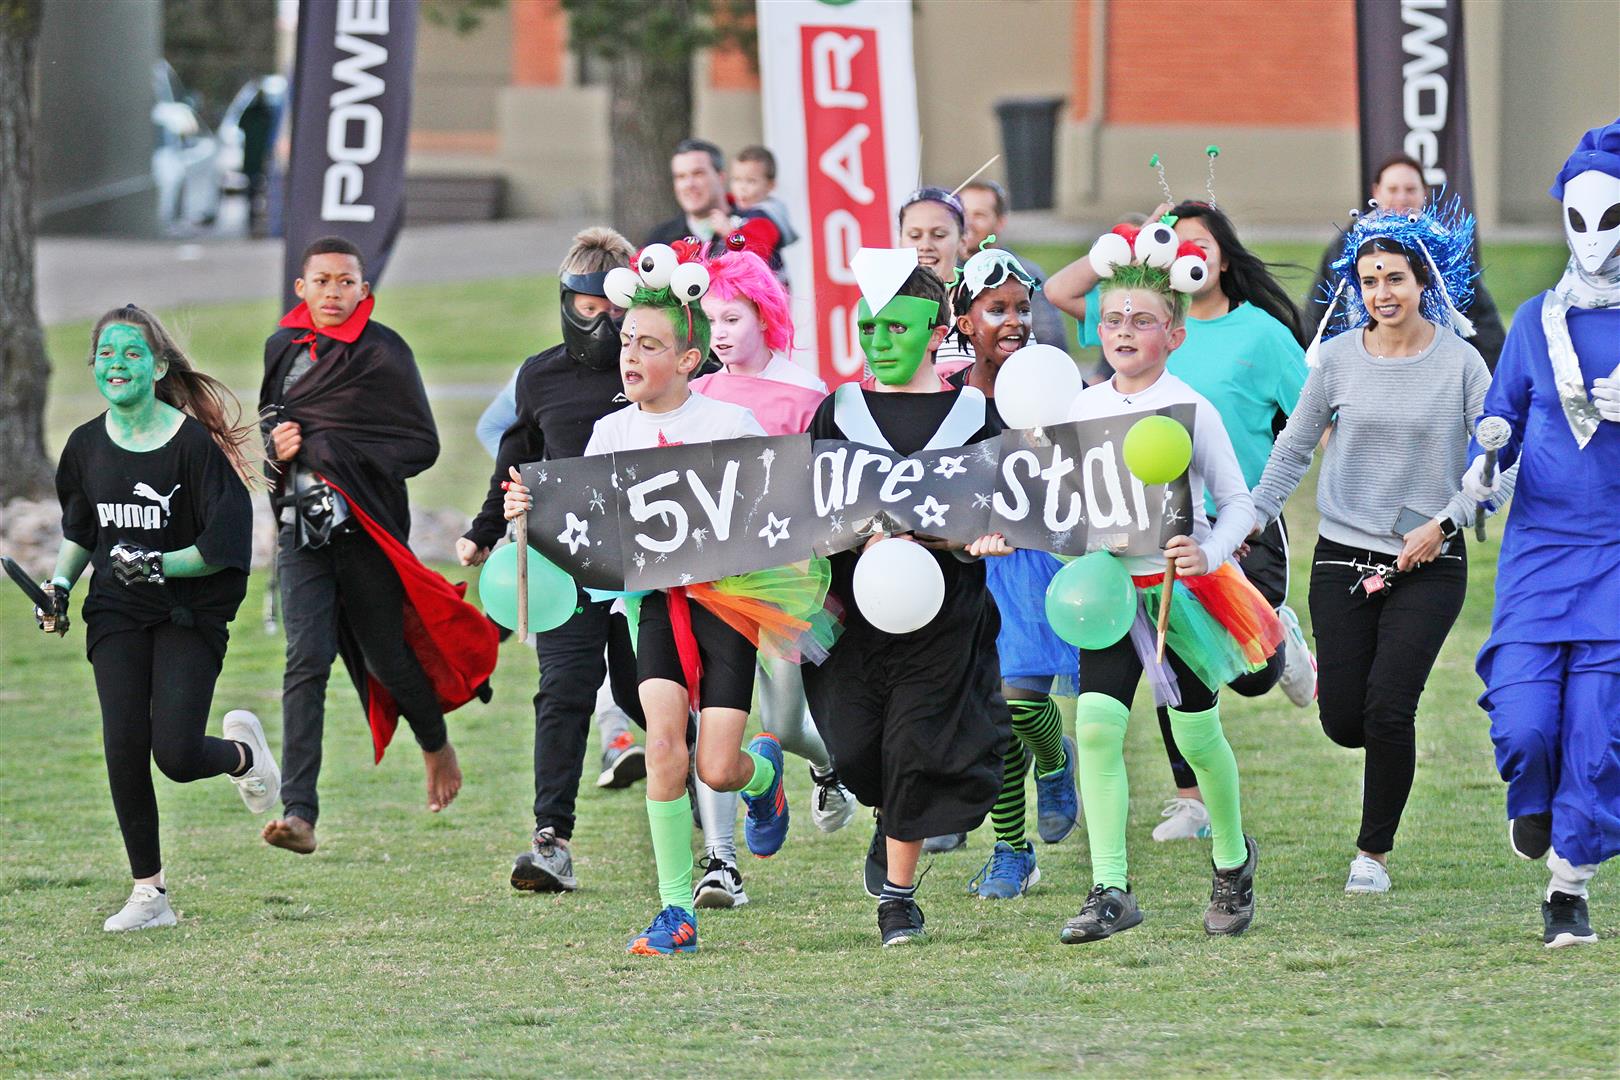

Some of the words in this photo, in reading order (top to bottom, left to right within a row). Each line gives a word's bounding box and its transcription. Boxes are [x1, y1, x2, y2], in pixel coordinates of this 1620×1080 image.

[321, 0, 390, 222] POWE
[1401, 0, 1449, 186] POW
[97, 503, 161, 530] PUMA
[627, 459, 740, 552] 5V
[813, 447, 925, 517] are
